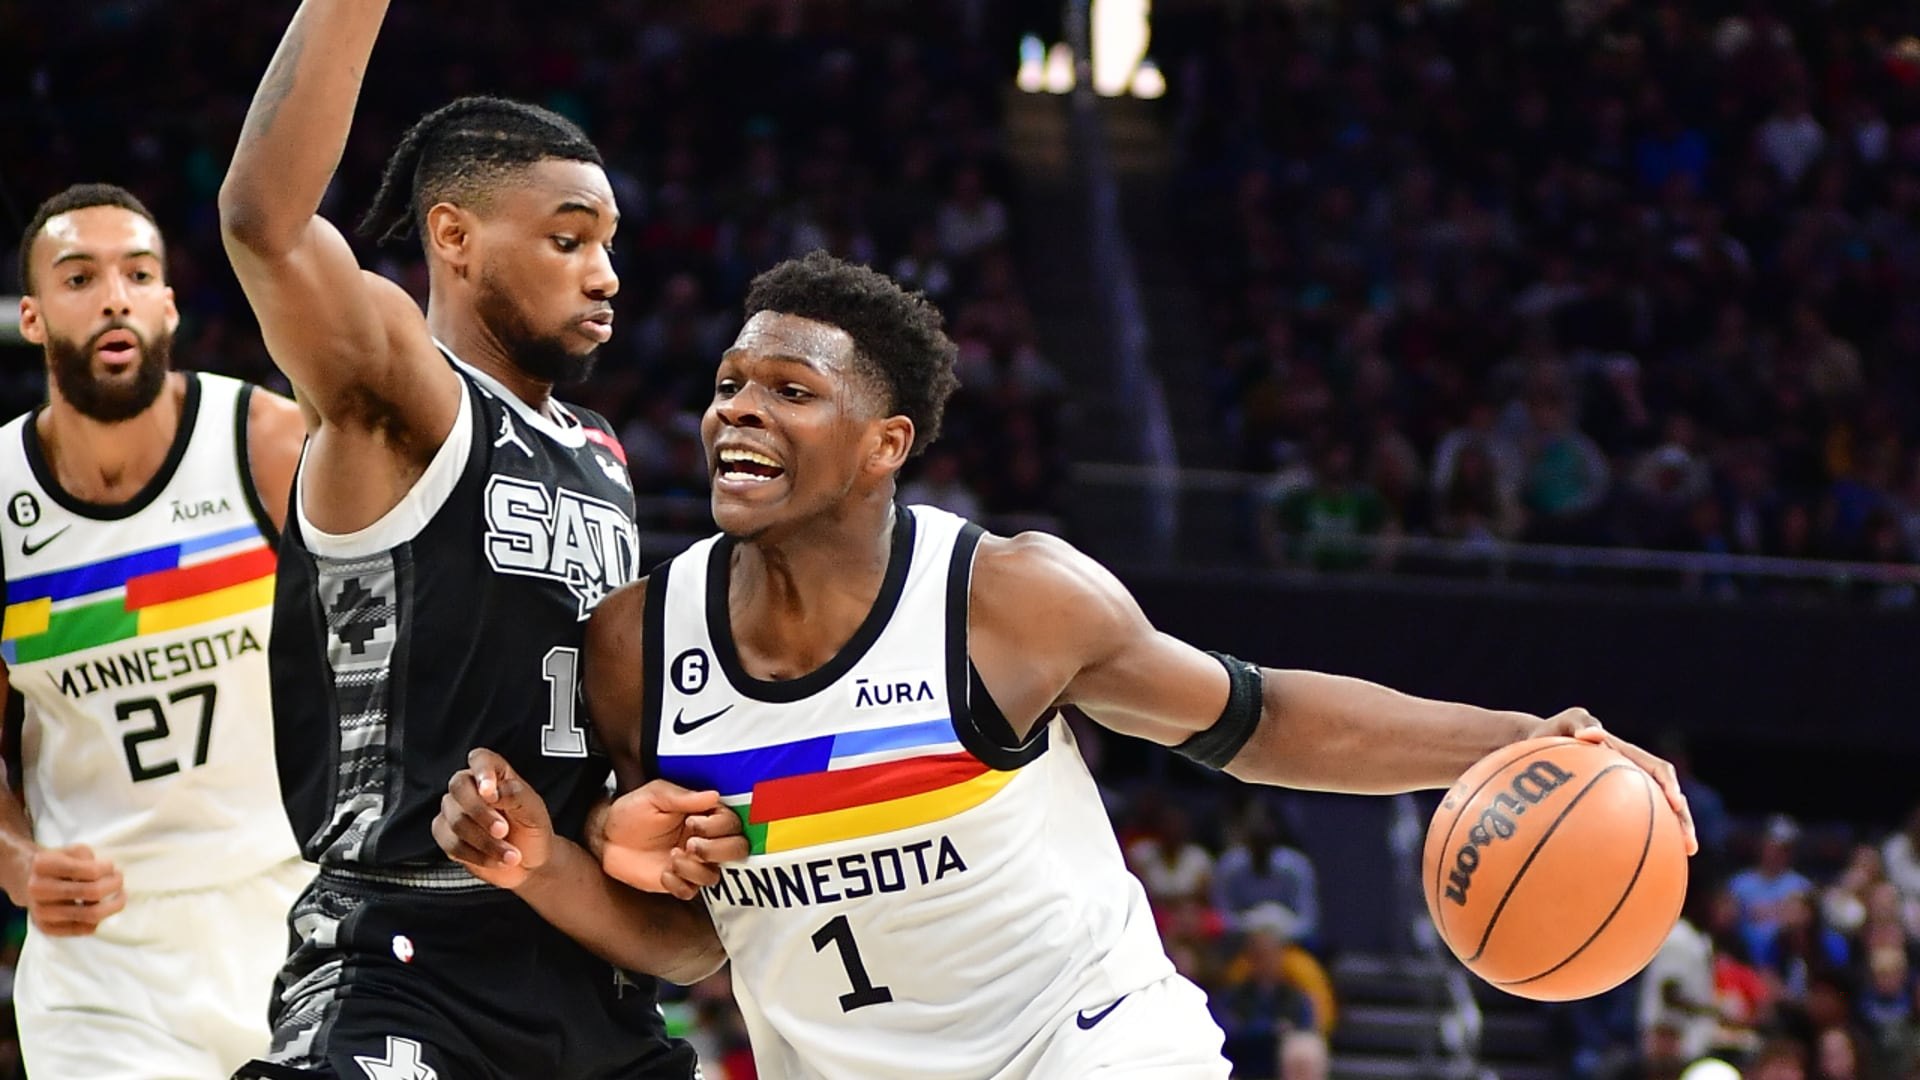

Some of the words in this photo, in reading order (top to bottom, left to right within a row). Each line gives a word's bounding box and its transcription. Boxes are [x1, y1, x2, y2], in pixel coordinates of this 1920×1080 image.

[171, 498, 232, 523] ĀURA
[484, 473, 641, 587] SAT
[46, 626, 262, 699] MINNESOTA
[541, 645, 589, 757] 1
[682, 653, 702, 687] 6
[855, 678, 935, 708] ĀURA
[115, 681, 217, 783] 27
[702, 835, 967, 909] MINNESOTA
[1445, 760, 1575, 906] Wilson
[811, 914, 894, 1013] 1
